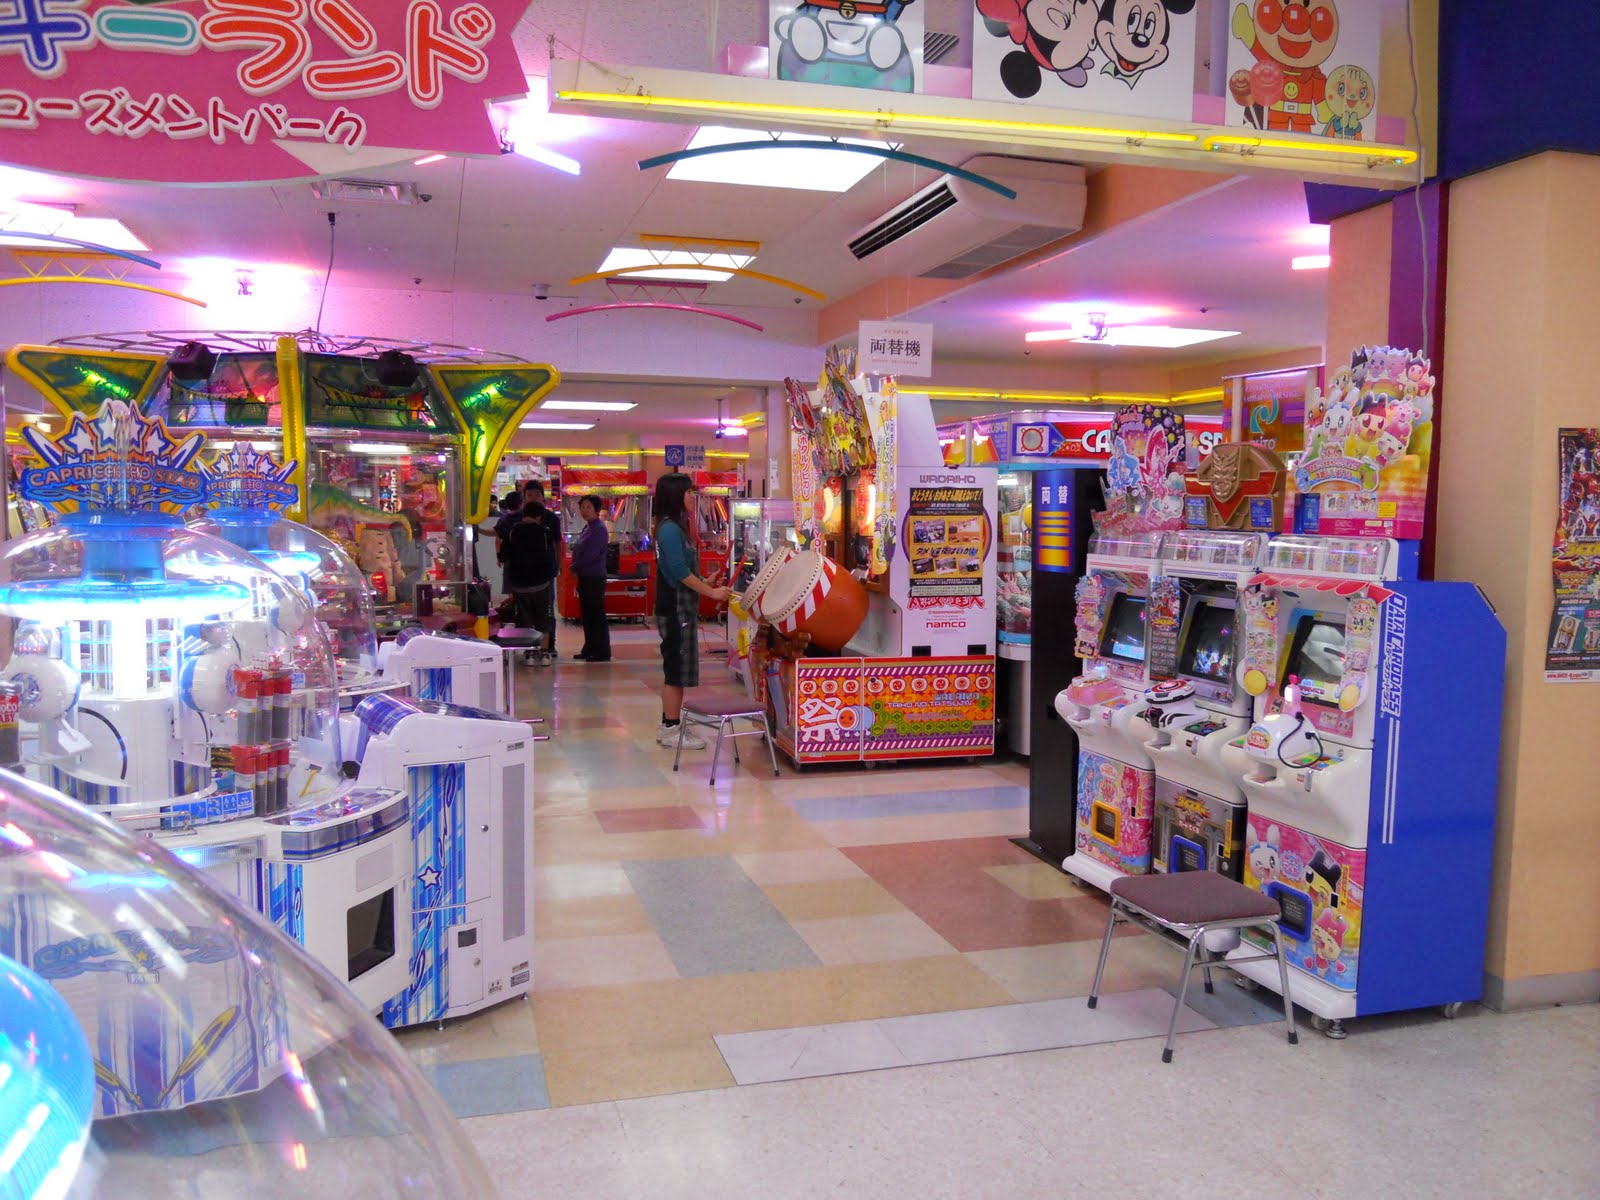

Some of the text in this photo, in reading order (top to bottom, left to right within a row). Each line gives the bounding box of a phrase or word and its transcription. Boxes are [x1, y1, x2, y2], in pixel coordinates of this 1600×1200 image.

[870, 338, 921, 357] 両替機
[153, 468, 200, 489] STAR
[1041, 486, 1068, 504] 両替
[801, 697, 842, 742] 祭
